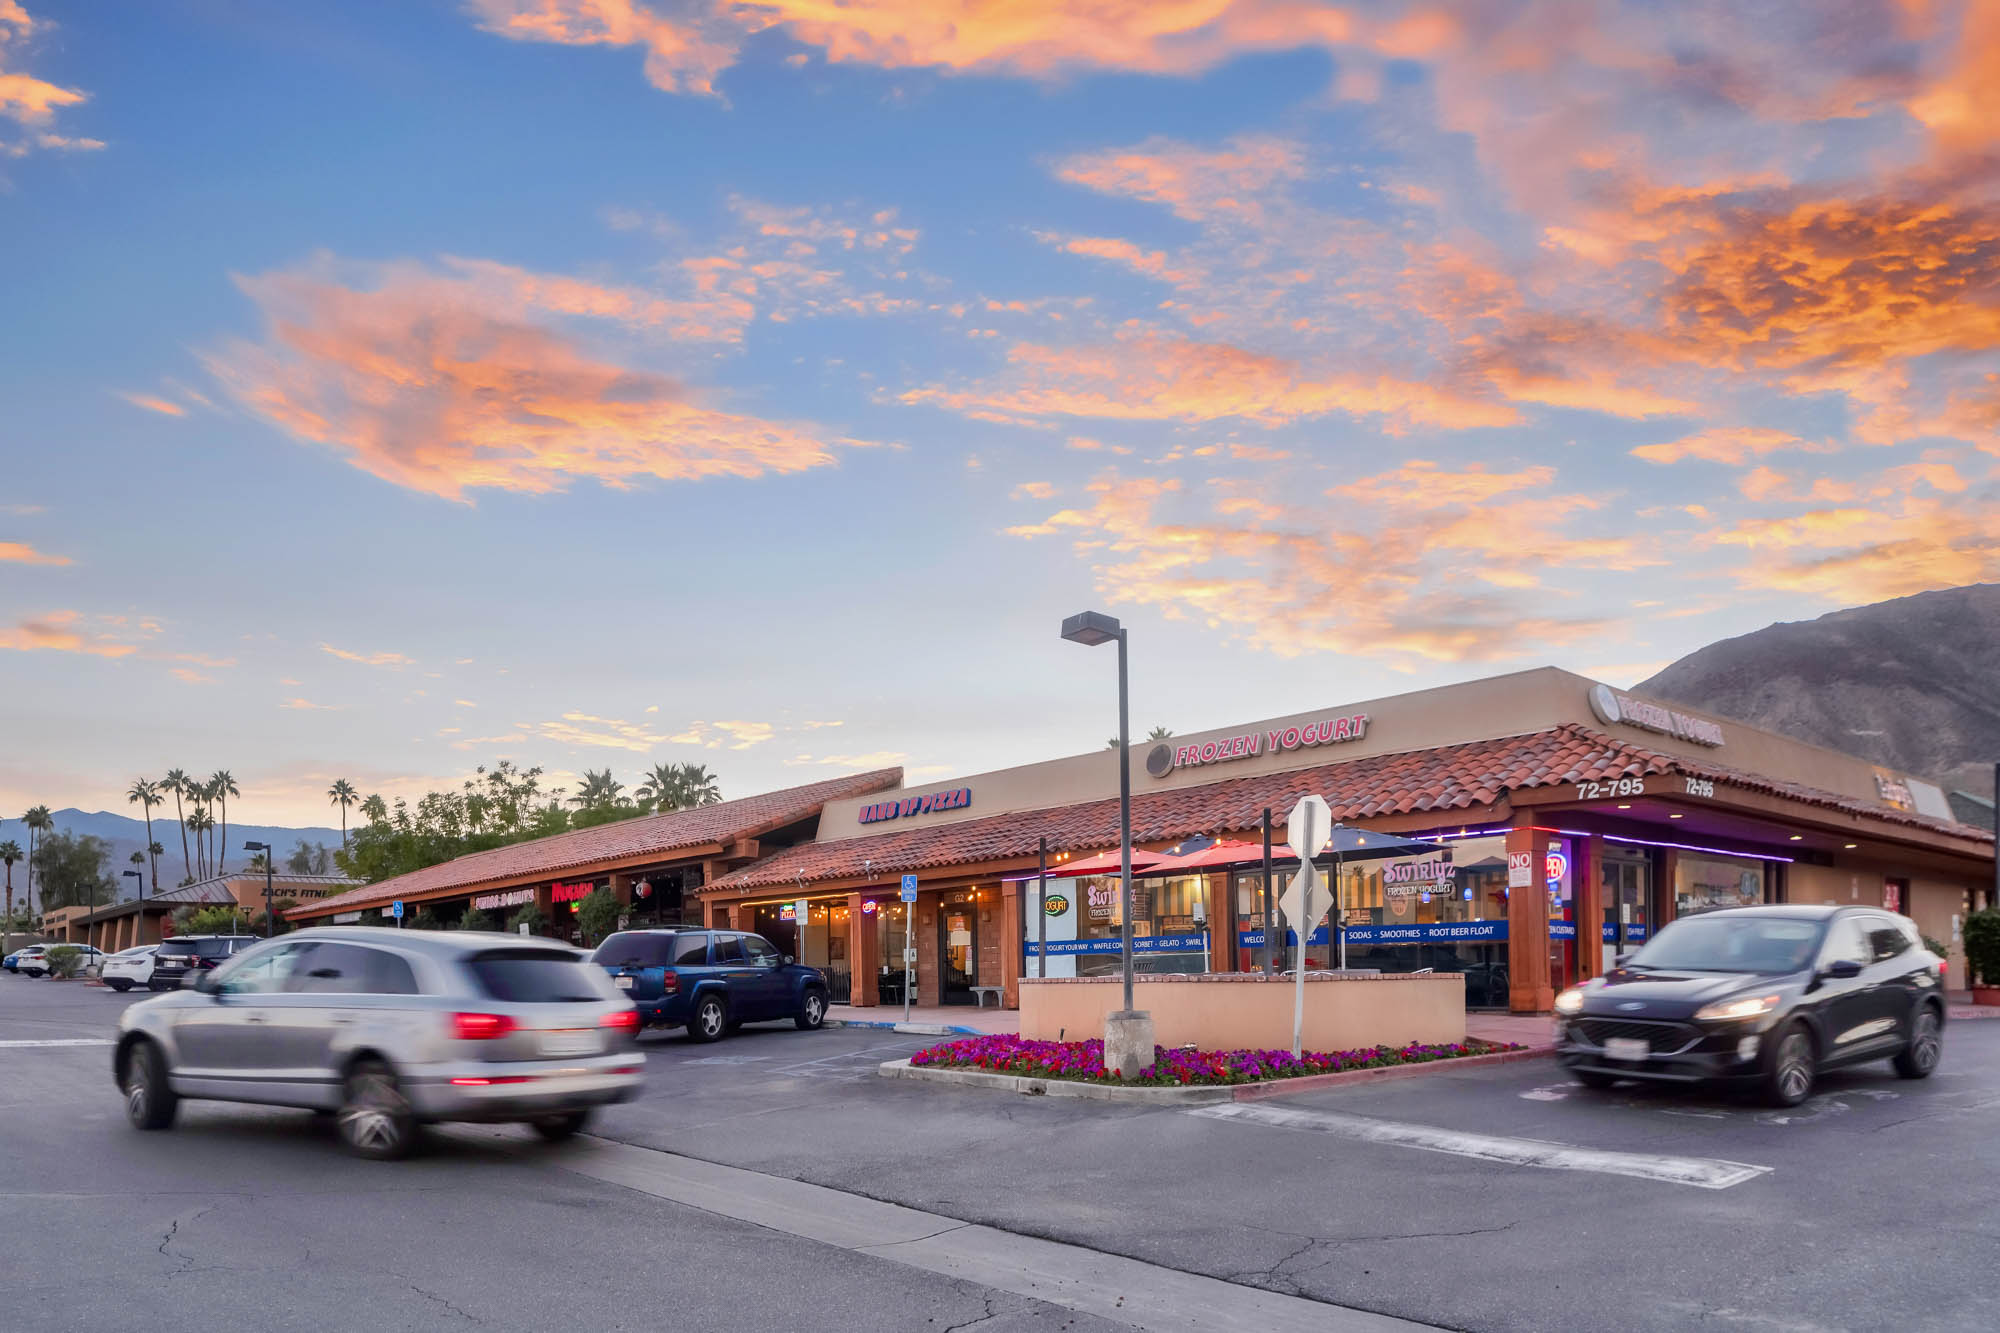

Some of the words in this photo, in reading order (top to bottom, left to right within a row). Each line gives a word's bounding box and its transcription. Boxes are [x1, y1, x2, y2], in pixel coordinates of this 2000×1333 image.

[1175, 735, 1261, 767] FROZEN
[1267, 715, 1367, 752] YOGURT
[1576, 778, 1644, 800] 72-795
[1685, 777, 1714, 797] 72-795
[858, 801, 898, 823] HAUS
[900, 797, 921, 816] OF
[921, 788, 970, 813] PIZZA
[1511, 854, 1530, 867] NO
[1547, 858, 1564, 878] PEN
[301, 889, 328, 898] FITNE
[1387, 886, 1417, 896] FROZEN
[1418, 883, 1452, 894] YOGURT
[1046, 901, 1067, 911] OGURT
[781, 910, 796, 919] PIZZA
[1349, 931, 1372, 939] SODAS
[1380, 929, 1420, 938] SMOOTHIES
[1429, 928, 1450, 936] ROOT
[1450, 927, 1469, 936] BEER
[1470, 926, 1494, 935] FLOAT
[1093, 942, 1112, 950] WAFFLE
